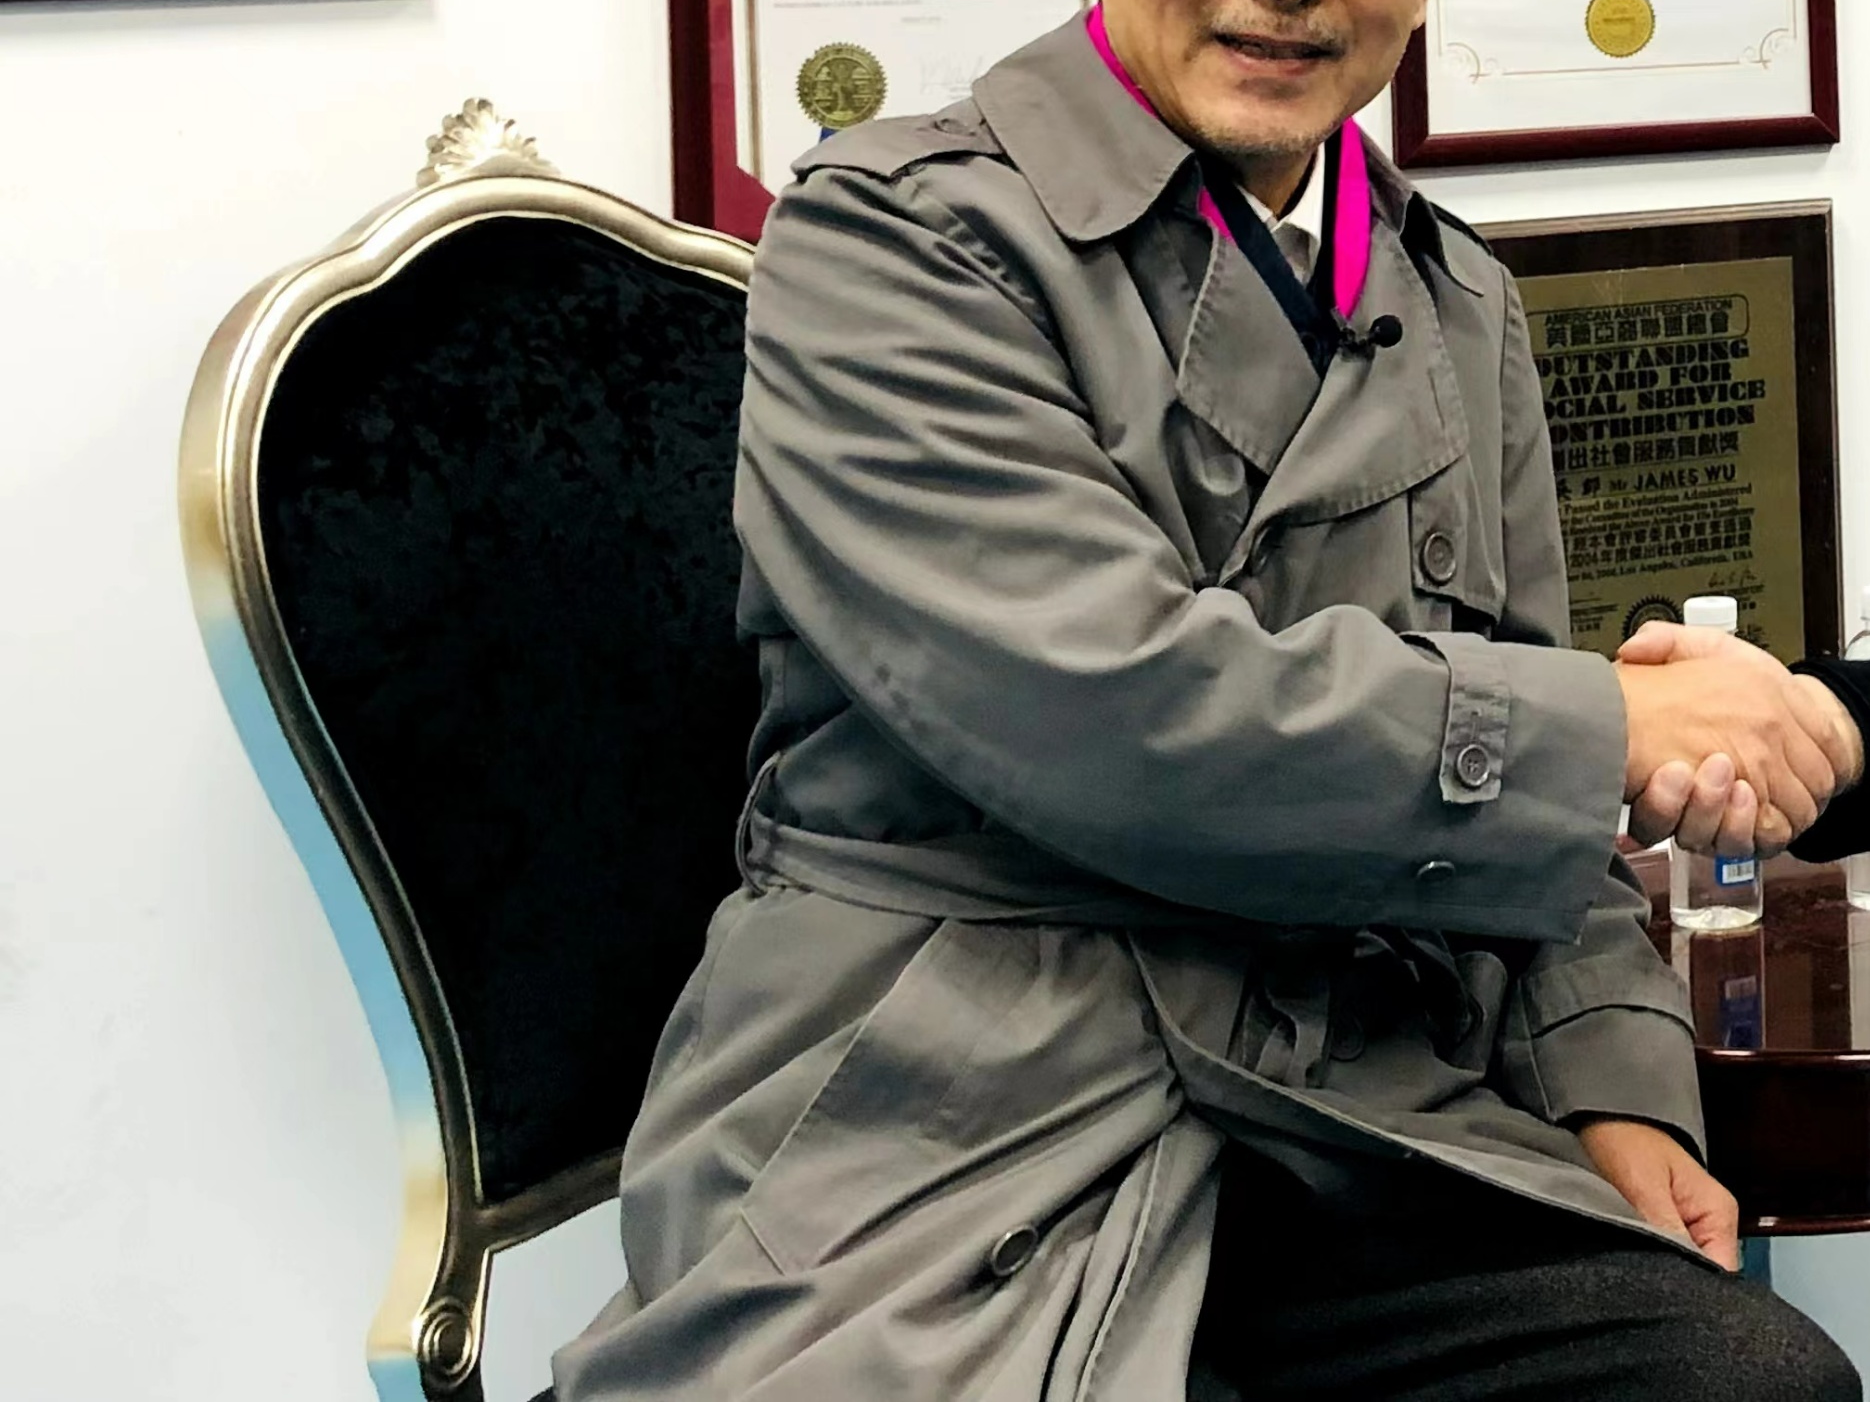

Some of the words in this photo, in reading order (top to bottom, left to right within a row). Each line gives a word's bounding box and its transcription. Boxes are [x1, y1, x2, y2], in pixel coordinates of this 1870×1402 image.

[1545, 310, 1611, 326] AMERICAN
[1614, 305, 1650, 319] ASIAN
[1654, 299, 1732, 316] FEDERATION
[1551, 369, 1659, 399] AWARD
[1669, 362, 1732, 386] FOR
[1638, 379, 1766, 410] SERVICE
[1550, 405, 1755, 444] ONTRIBUTION
[1634, 467, 1699, 491] JAMES
[1705, 463, 1736, 482] WU
[1683, 484, 1751, 501] Administered
